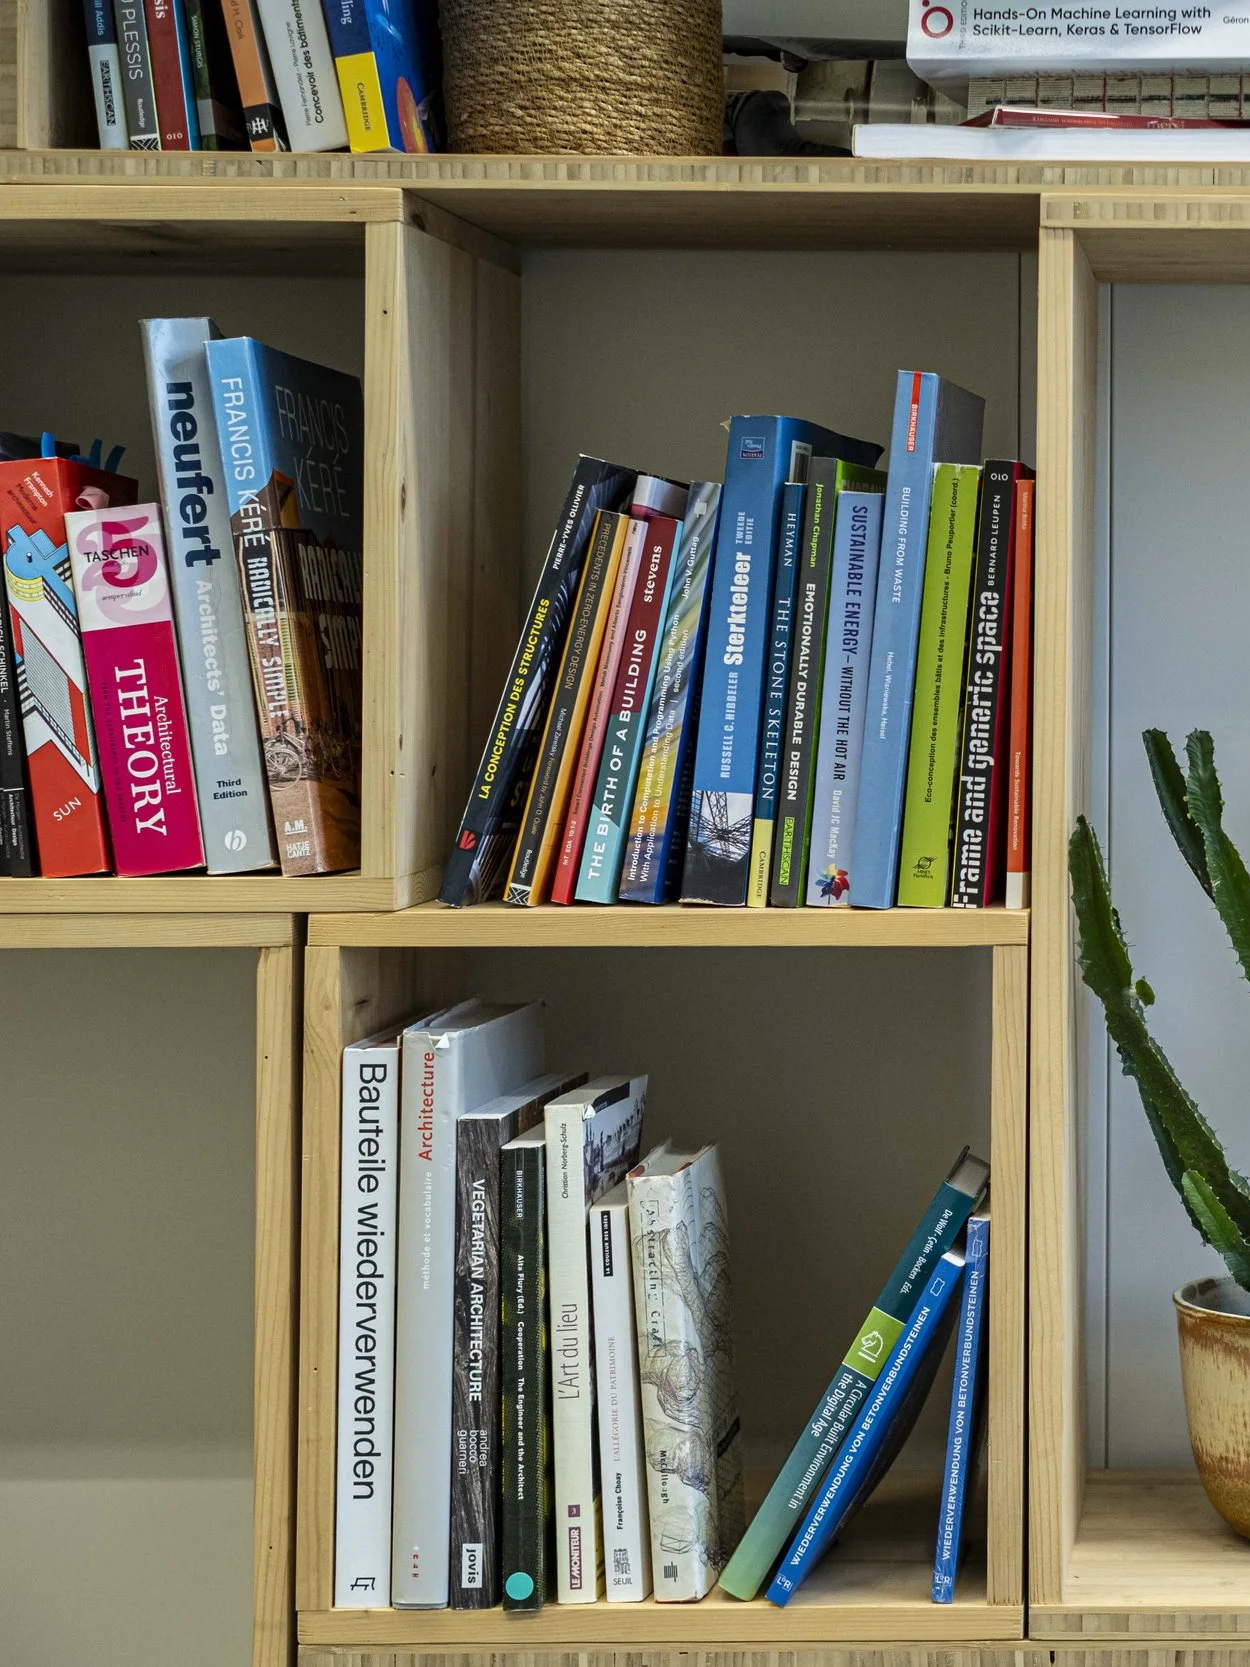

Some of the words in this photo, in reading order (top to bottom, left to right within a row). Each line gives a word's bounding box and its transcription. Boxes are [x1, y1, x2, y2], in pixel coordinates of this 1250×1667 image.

[190, 15, 199, 39] SIMON
[972, 24, 1062, 37] Scikit-Learn,
[1066, 23, 1105, 36] Keras
[1110, 24, 1119, 35] &
[1124, 23, 1202, 35] TensorFlow
[973, 7, 1046, 21] Hands-On
[1051, 7, 1111, 19] Machine
[1115, 7, 1177, 21] Learning
[1181, 6, 1211, 19] with
[1223, 15, 1249, 25] Géron
[121, 9, 143, 80] PLESSIS
[304, 55, 312, 69] des
[100, 60, 116, 126] EARTHSCAN
[308, 72, 324, 124] Concevoir
[356, 82, 371, 131] CAMBRIDGE
[137, 98, 146, 129] Routledge
[274, 384, 350, 455] FRANCIS
[166, 381, 221, 568] neufert
[221, 377, 255, 482] FRANCIS
[238, 489, 272, 548] KÉRÉ
[292, 443, 351, 517] KÉRÉ
[24, 477, 48, 507] Frampton
[32, 471, 54, 498] Kenneth
[814, 482, 824, 524] Jonathan
[552, 519, 574, 570] PIERRE-YVES
[569, 484, 585, 518] OLLIVIER
[735, 511, 746, 545] TWEEDE
[899, 487, 911, 534] BUILDING
[992, 494, 1001, 535] LEUPEN
[745, 517, 755, 545] EDITIE
[783, 513, 797, 567] HEYMAN
[809, 525, 820, 568] Chapman
[84, 545, 150, 563] TASCHEN
[591, 522, 612, 581] PRECEDENTS
[687, 536, 700, 568] Guttag
[846, 505, 868, 597] SUSTAINABLE
[896, 537, 907, 566] FROM
[987, 537, 999, 586] BERNARD
[587, 582, 599, 594] IN
[643, 545, 663, 604] stevens
[682, 579, 692, 601] John
[685, 569, 693, 579] V.
[892, 569, 904, 604] WASTE
[248, 556, 280, 647] RADICALLY
[723, 552, 752, 665] Sterkteleer
[775, 597, 791, 632] THE
[196, 580, 225, 697] Architects'
[519, 598, 550, 675] STRUCTURES
[572, 594, 597, 657] ZERO-ENERGY
[667, 613, 681, 646] Python
[676, 628, 689, 660] edition
[797, 583, 816, 681] EMOTIONALLY
[842, 600, 862, 655] ENERGY
[976, 591, 1003, 665] space
[564, 657, 581, 690] DESIGN
[619, 629, 647, 723] BUILDING
[662, 647, 675, 673] Using
[671, 660, 684, 693] second
[770, 640, 787, 699] STONE
[262, 656, 289, 719] SIMPLE
[510, 676, 526, 704] DES
[652, 674, 671, 735] Programming
[725, 672, 739, 720] HIBBELER
[839, 667, 854, 713] WITHOUT
[210, 705, 228, 756] Data
[664, 709, 676, 730] Data
[725, 720, 734, 733] C.
[792, 682, 806, 745] DURABLE
[837, 714, 850, 735] THE
[968, 671, 995, 768] generic
[114, 658, 167, 837] THEORY
[154, 696, 181, 796] Architectural
[484, 706, 517, 783] CONCEPTION
[616, 728, 630, 742] A
[649, 735, 659, 753] and
[761, 709, 781, 800] SKELETON
[835, 736, 849, 760] HOT
[610, 745, 626, 772] OF
[653, 731, 674, 797] Understanding
[720, 734, 733, 779] RUSSELL
[786, 751, 801, 801] DESIGN
[833, 761, 847, 781] AIR
[213, 788, 248, 800] Edition
[216, 778, 242, 789] Third
[478, 786, 491, 799] LA
[638, 754, 657, 813] Computation
[652, 798, 661, 808] to
[832, 790, 842, 813] David
[960, 775, 987, 823] and
[1013, 778, 1021, 814] Sustainable
[53, 797, 82, 822] SUN
[284, 819, 308, 832] A.M.
[599, 777, 621, 836] BIRTH
[637, 814, 646, 824] to
[832, 814, 841, 825] JC
[286, 841, 310, 851] HATJE
[287, 848, 311, 859] CANTZ
[627, 825, 644, 881] Introduction
[642, 809, 661, 860] Application
[779, 817, 795, 885] EARTHSCAN
[827, 826, 841, 859] MacKay
[519, 849, 532, 879] Routledge
[588, 839, 607, 880] THE
[639, 860, 650, 883] With
[756, 851, 767, 898] CAMBRIDGE
[952, 829, 983, 908] Frame
[417, 1051, 435, 1162] Architecture
[357, 1063, 388, 1193] Bauteile
[561, 1122, 569, 1171] Norberg-Schulz
[424, 1171, 433, 1230] vocabulaire
[561, 1172, 569, 1199] Christian
[424, 1232, 431, 1243] et
[470, 1179, 486, 1279] VEGETARIAN
[423, 1247, 431, 1290] méthode
[556, 1303, 578, 1331] lieu
[352, 1201, 385, 1500] wiederverwenden
[469, 1282, 485, 1402] ARCHITECTURE
[561, 1332, 579, 1359] du
[957, 1270, 980, 1408] BETONVERBUNDSTEINEN
[558, 1360, 580, 1400] L'Art
[836, 1371, 855, 1391] the
[854, 1379, 867, 1391] A
[817, 1386, 846, 1420] Digital
[835, 1386, 864, 1424] Circular
[791, 1455, 854, 1565] WIEDERVERWENDUNG
[848, 1436, 864, 1454] VON
[861, 1306, 931, 1430] BETONVERBUNDSTEINEN
[806, 1415, 828, 1439] Age
[823, 1420, 845, 1446] Built
[955, 1413, 965, 1436] VON
[457, 1429, 470, 1475] guarneri
[469, 1429, 480, 1463] bocco
[478, 1429, 491, 1467] andrea
[615, 1471, 623, 1494] Choay
[791, 1442, 833, 1501] Environment
[616, 1494, 624, 1530] Françoise
[786, 1497, 801, 1511] in
[942, 1437, 962, 1561] WIEDERVERWENDUNG
[466, 1548, 480, 1584] jovis
[613, 1577, 633, 1586] SEUIL
